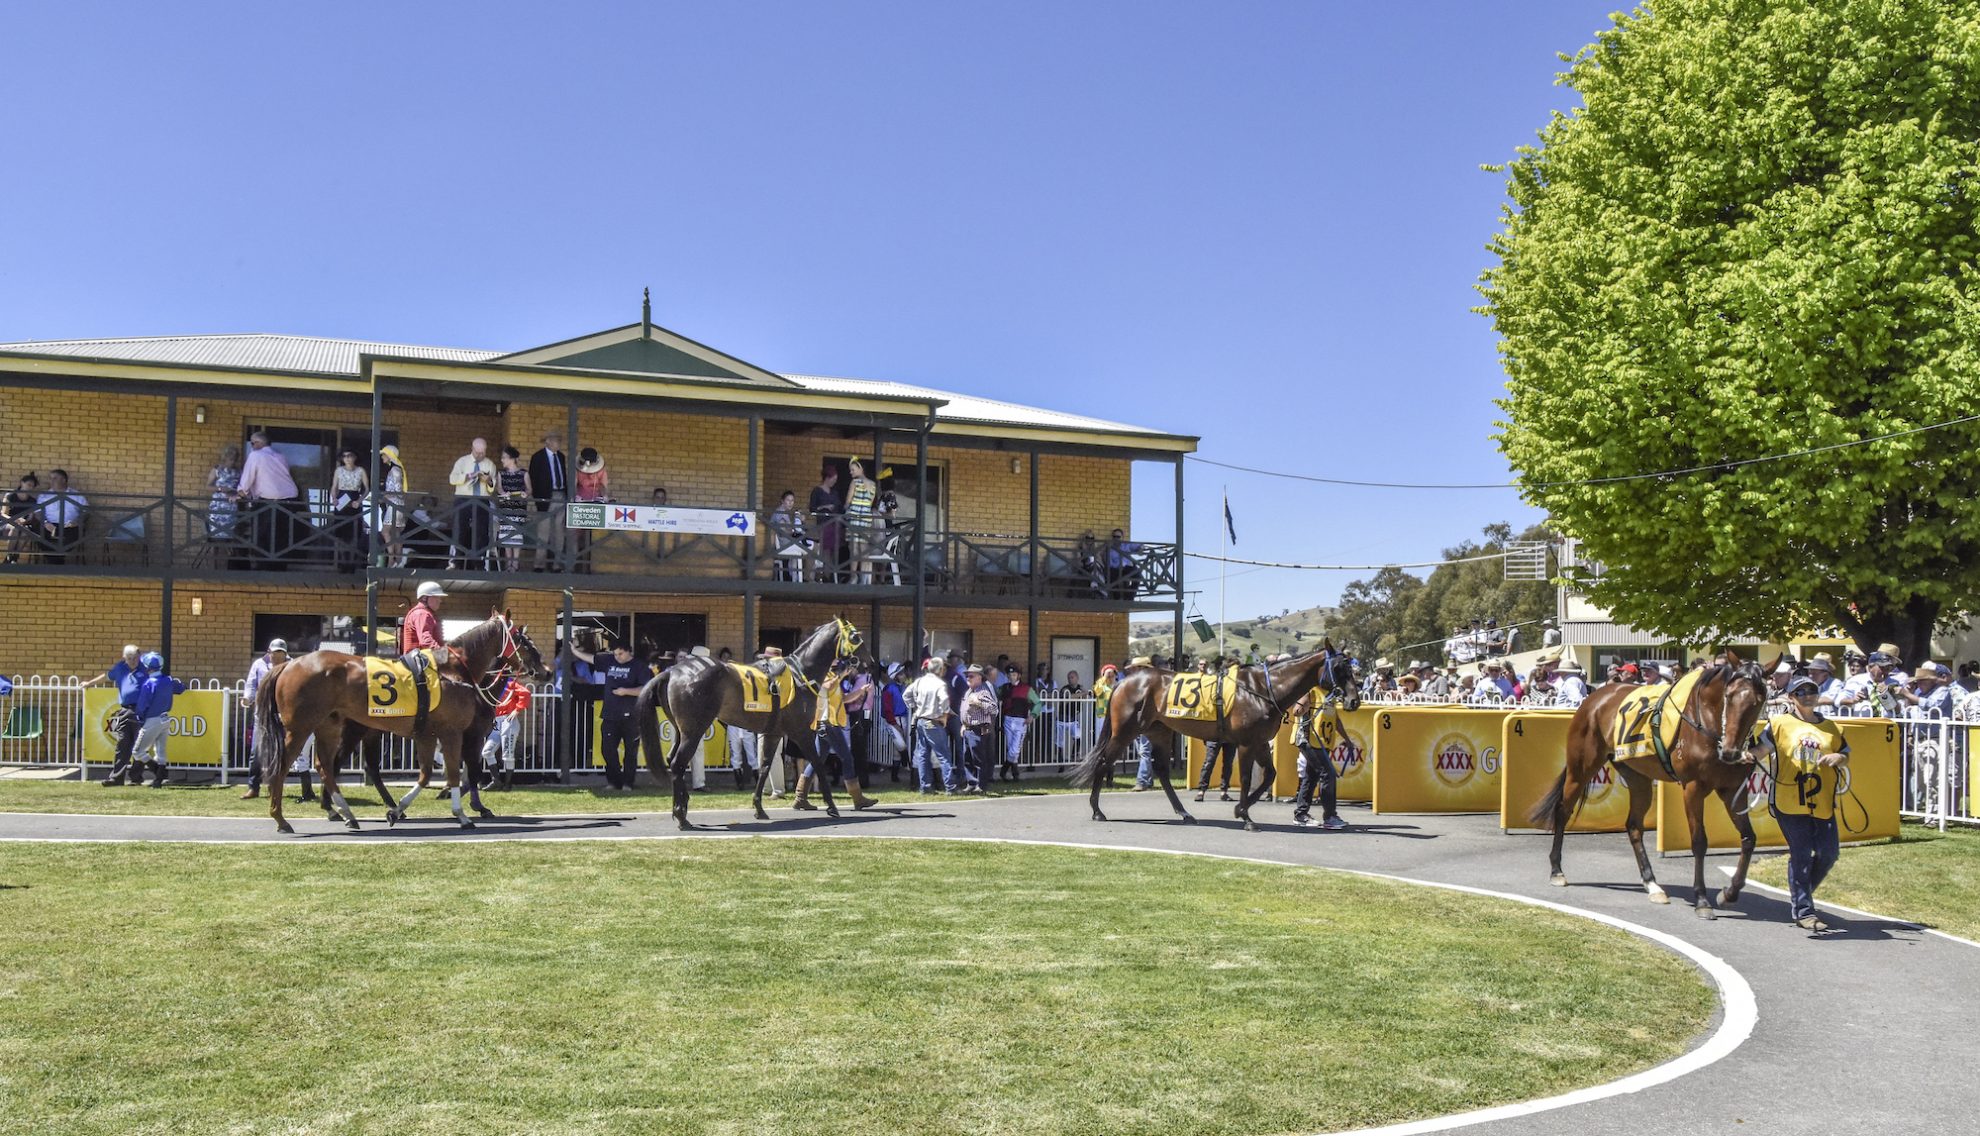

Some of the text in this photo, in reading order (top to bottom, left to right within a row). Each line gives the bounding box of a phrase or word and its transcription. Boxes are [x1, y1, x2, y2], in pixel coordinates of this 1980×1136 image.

[572, 506, 601, 514] Cleveden
[372, 670, 398, 706] 3
[745, 670, 758, 701] 1
[1173, 678, 1201, 708] 13
[1382, 713, 1392, 730] 3
[1514, 719, 1523, 737] 4
[1616, 696, 1649, 746] 12
[1885, 725, 1894, 742] 5
[1799, 738, 1820, 750] XXXX
[1436, 752, 1474, 770] XXXX
